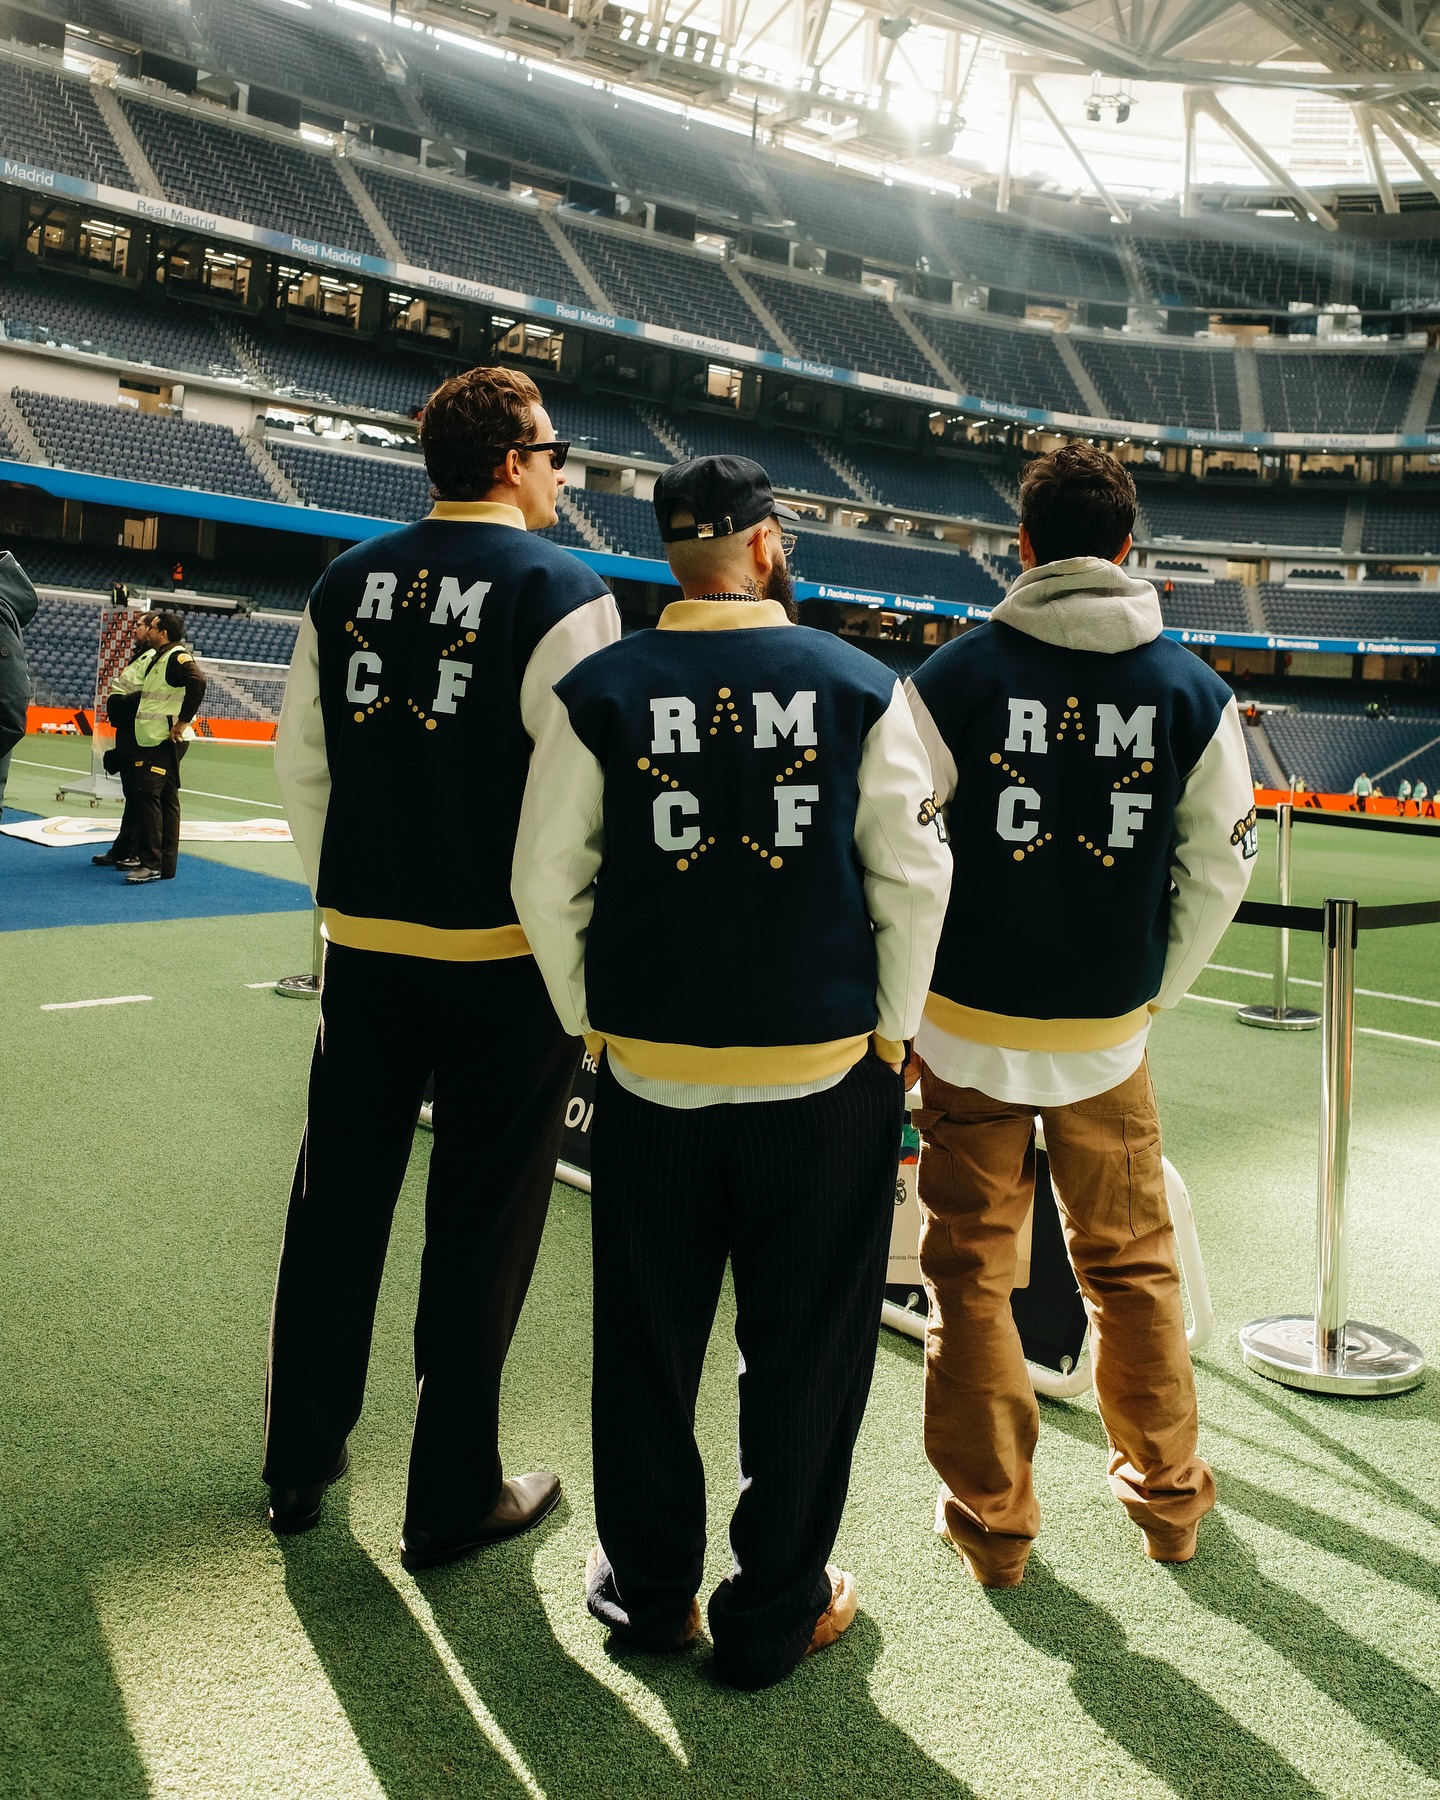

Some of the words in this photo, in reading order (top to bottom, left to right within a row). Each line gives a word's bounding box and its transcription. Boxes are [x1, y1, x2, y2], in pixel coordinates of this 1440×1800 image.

[4, 161, 55, 187] Madrid
[137, 200, 167, 219] Real
[171, 207, 217, 232] Madrid
[291, 239, 322, 256] Real
[322, 245, 362, 267] Madrid
[429, 275, 453, 291] Real
[457, 282, 495, 301] Madrid
[556, 305, 581, 320] Real
[583, 309, 615, 328] Madrid
[672, 334, 693, 348] Real
[696, 339, 730, 356] Madrid
[782, 358, 802, 371] Real
[804, 361, 834, 378] Madrid
[883, 381, 902, 394] Real
[904, 385, 934, 400] Madrid
[980, 400, 998, 412] Real
[1000, 403, 1028, 418] Madrid
[1077, 418, 1096, 430] Real
[1099, 421, 1132, 435] Madrid
[1187, 429, 1208, 441] Real
[1210, 430, 1244, 443] Madrid
[1303, 437, 1326, 447] Real
[1329, 437, 1366, 448] Madrid
